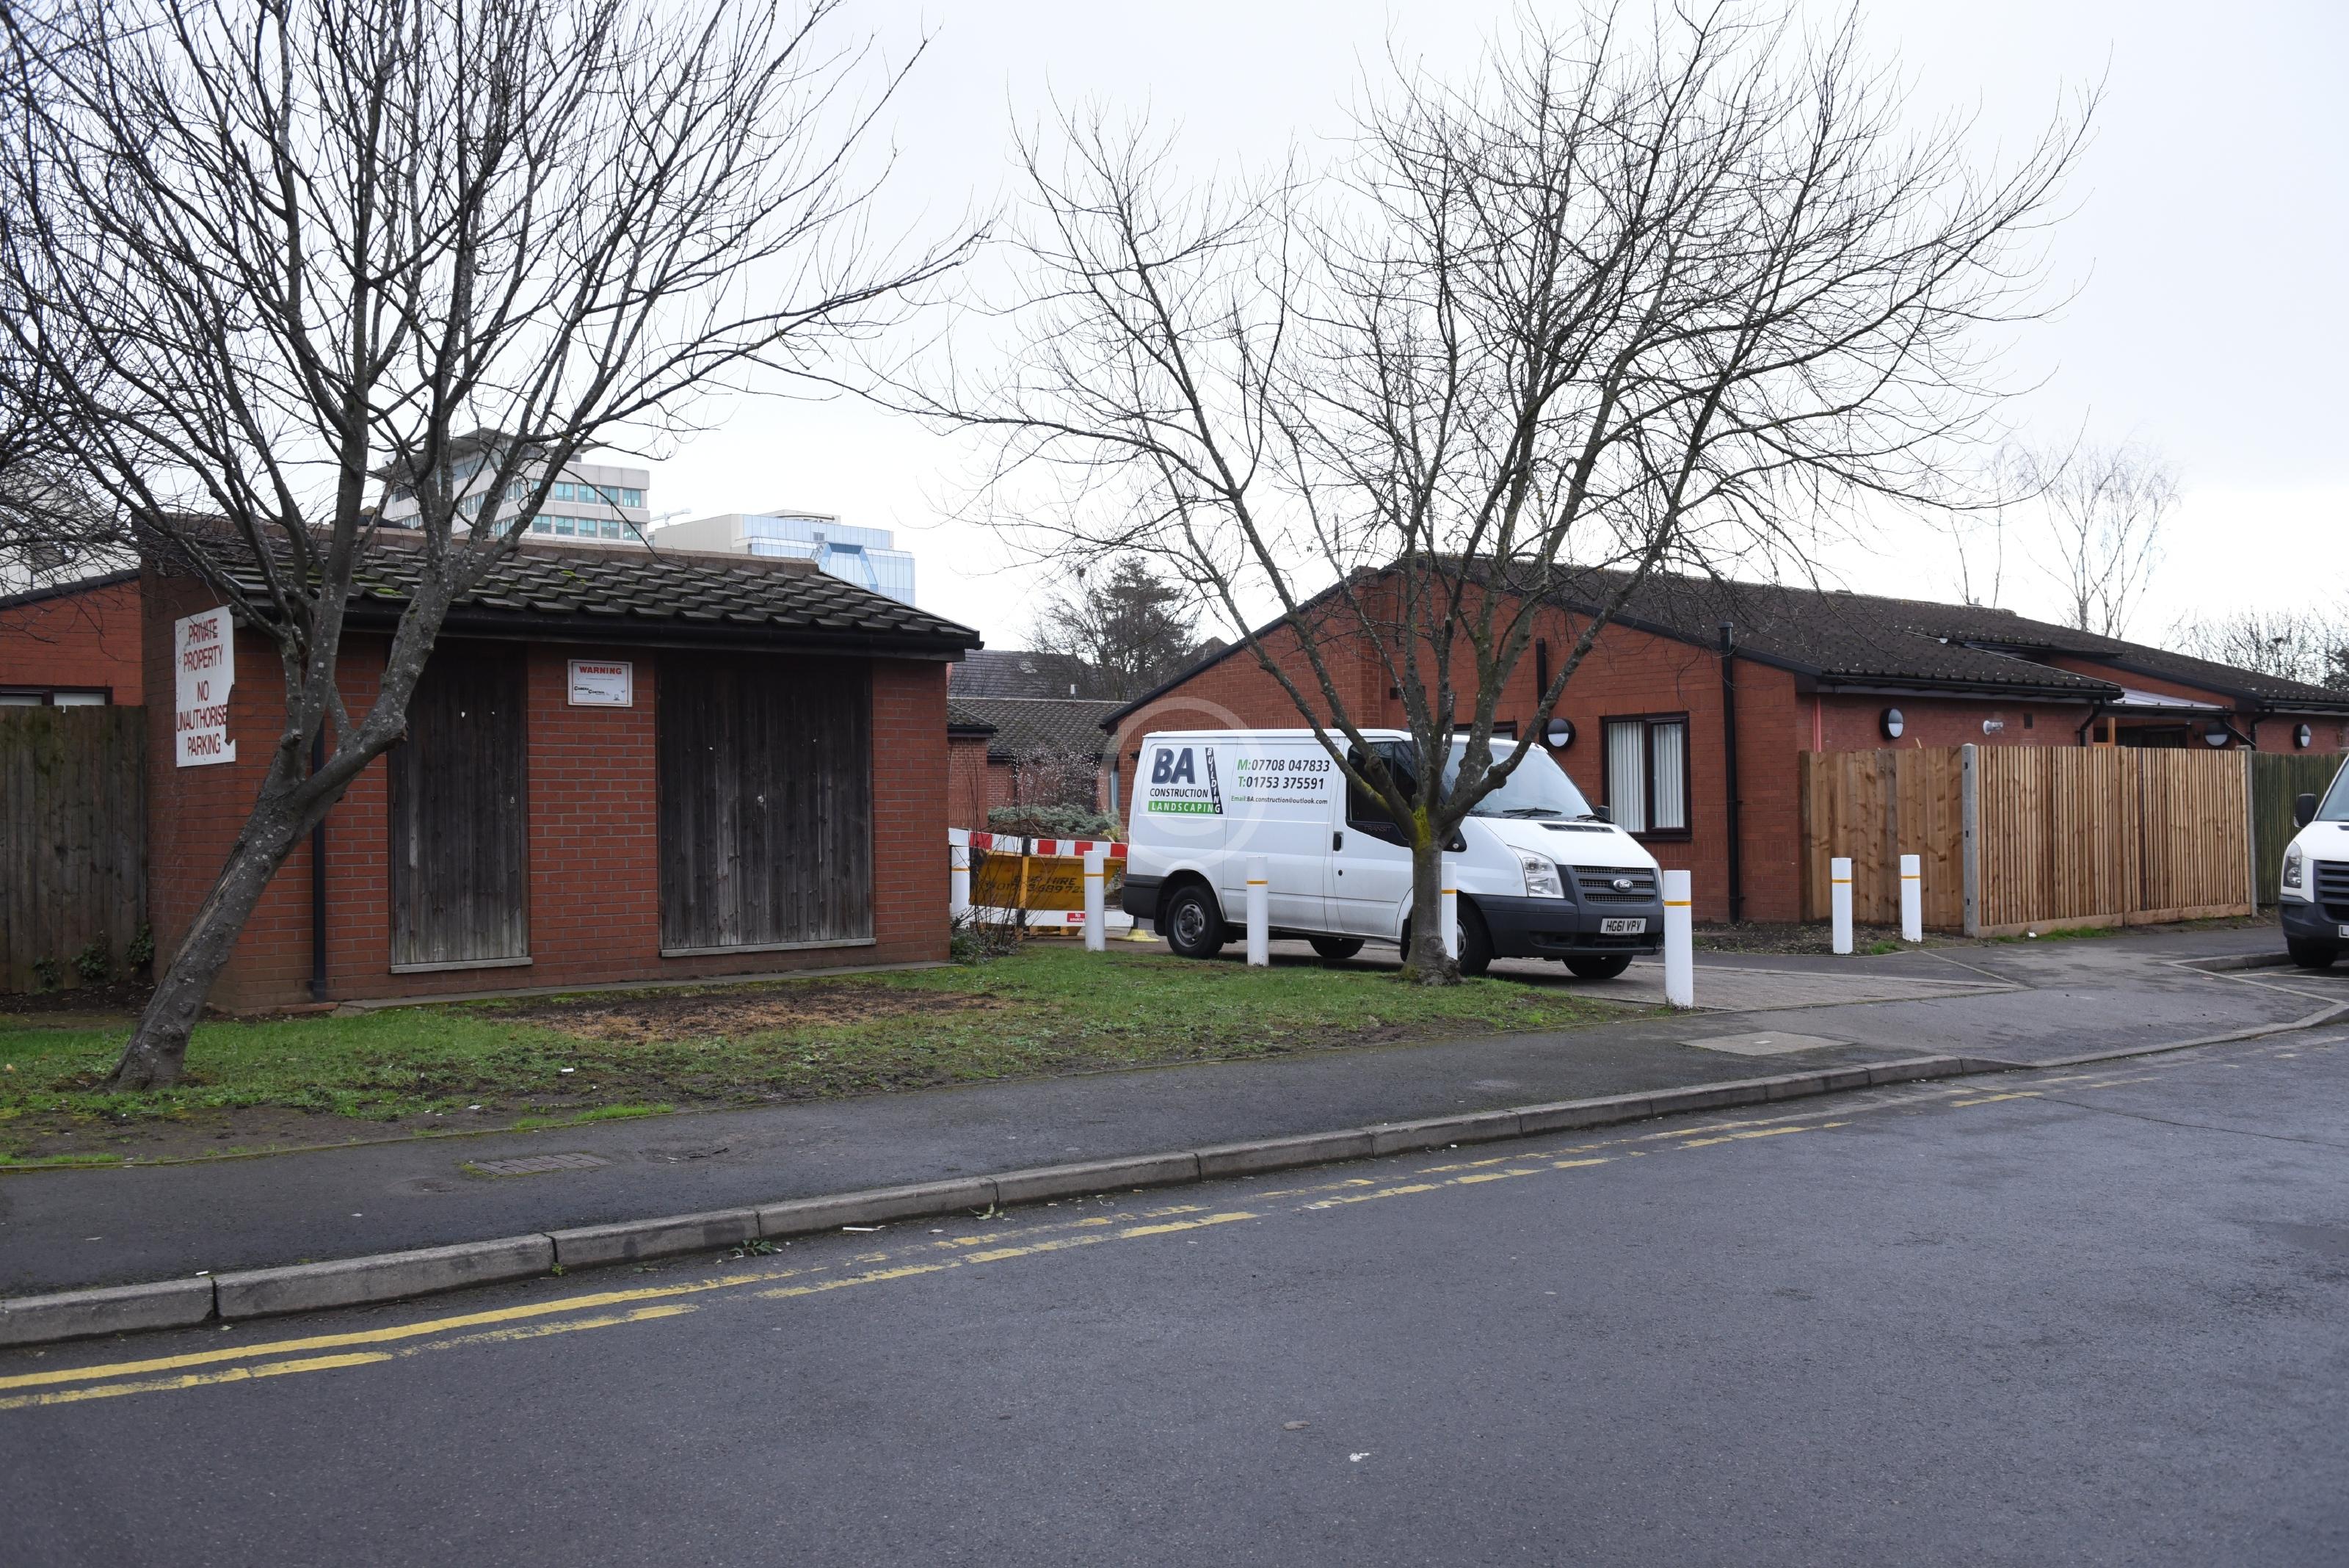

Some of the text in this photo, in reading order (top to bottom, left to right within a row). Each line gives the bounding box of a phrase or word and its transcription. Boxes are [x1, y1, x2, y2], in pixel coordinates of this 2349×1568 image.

[189, 618, 218, 645] PRIVATE
[184, 644, 223, 672] PROPERTY
[579, 666, 622, 675] WARNING
[197, 680, 209, 702] NO
[188, 733, 220, 757] PARKING
[1151, 747, 1196, 784] BA
[1237, 759, 1330, 772] M:07708 047833
[1206, 747, 1220, 813] BUILDING
[1238, 776, 1324, 790] T:01753 375591
[1150, 788, 1208, 798] CONSTRUCTION
[1151, 802, 1220, 813] LANDSCAPING
[1606, 921, 1624, 932] HG61
